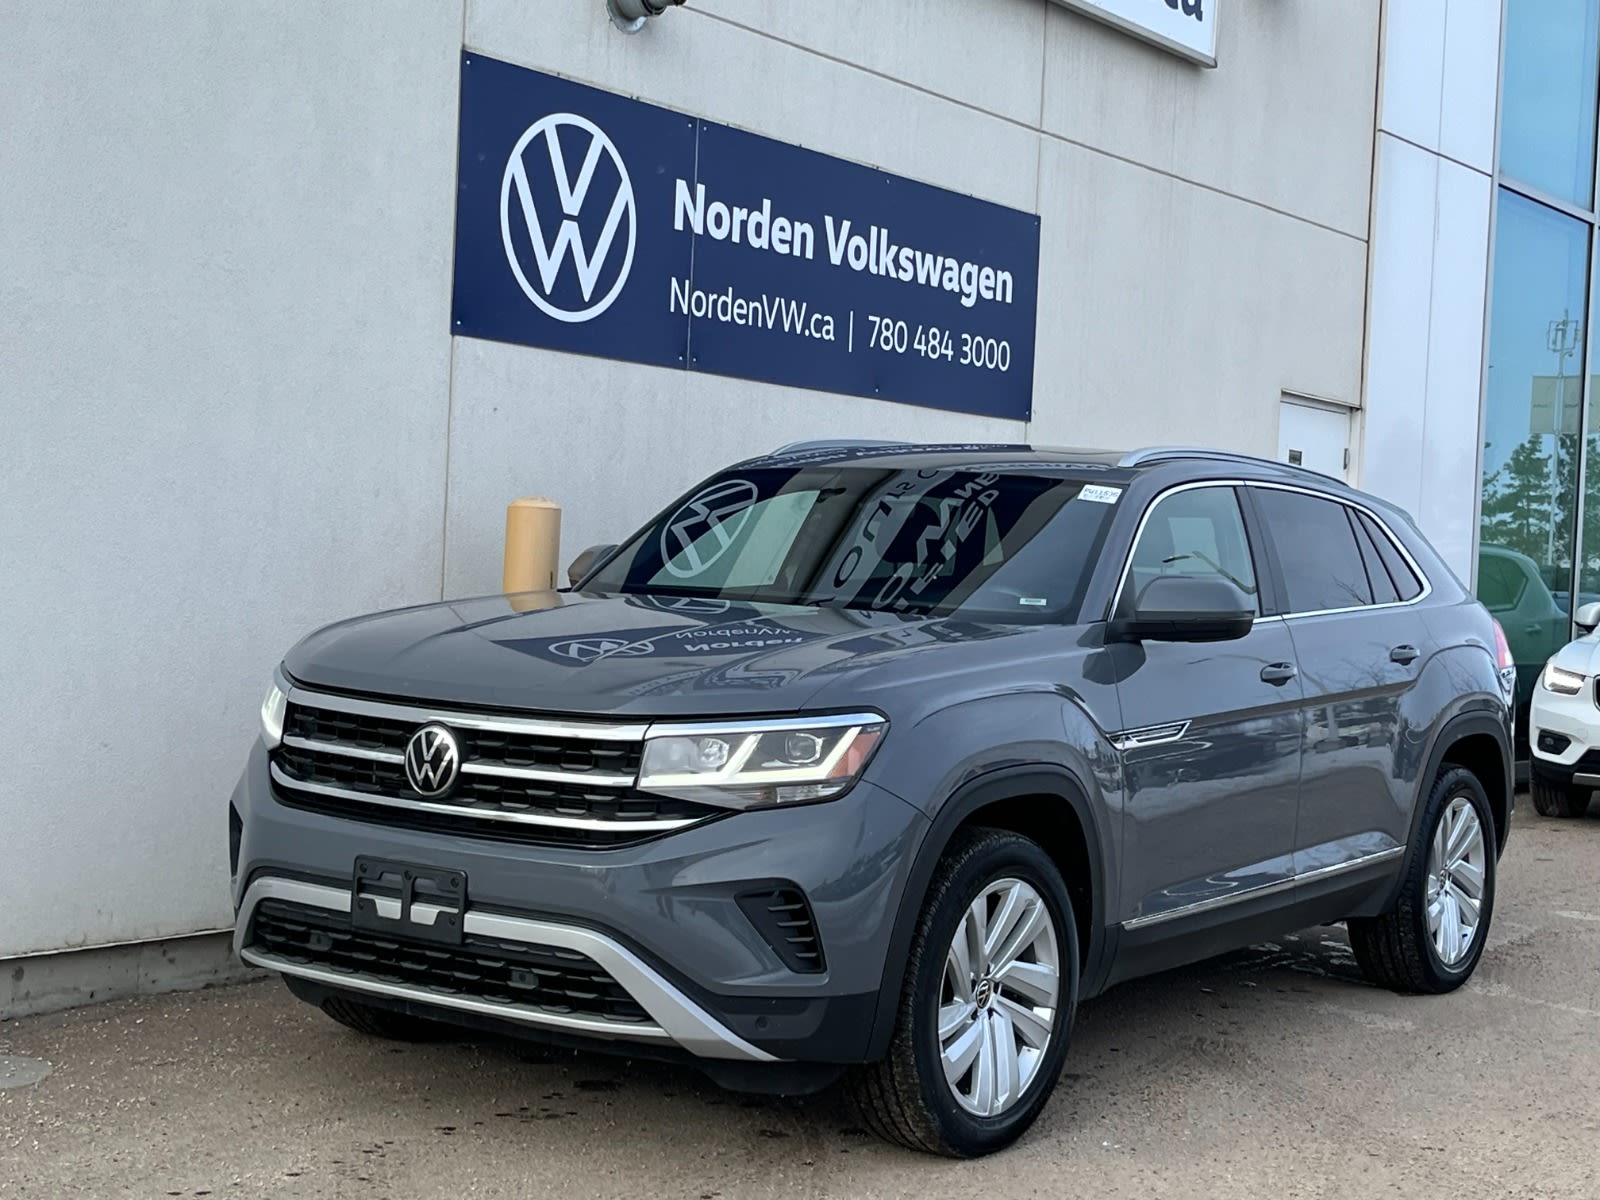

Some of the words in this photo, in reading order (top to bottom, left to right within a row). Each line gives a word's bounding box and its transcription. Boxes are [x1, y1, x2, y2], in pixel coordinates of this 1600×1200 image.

[501, 113, 636, 323] VW
[674, 178, 815, 260] Norden
[824, 215, 1013, 308] Volkswagen
[669, 276, 835, 342] NordenVW.ca
[868, 315, 908, 354] 780
[913, 325, 954, 362] 484
[959, 333, 1011, 372] 3000
[405, 725, 458, 795] VW
